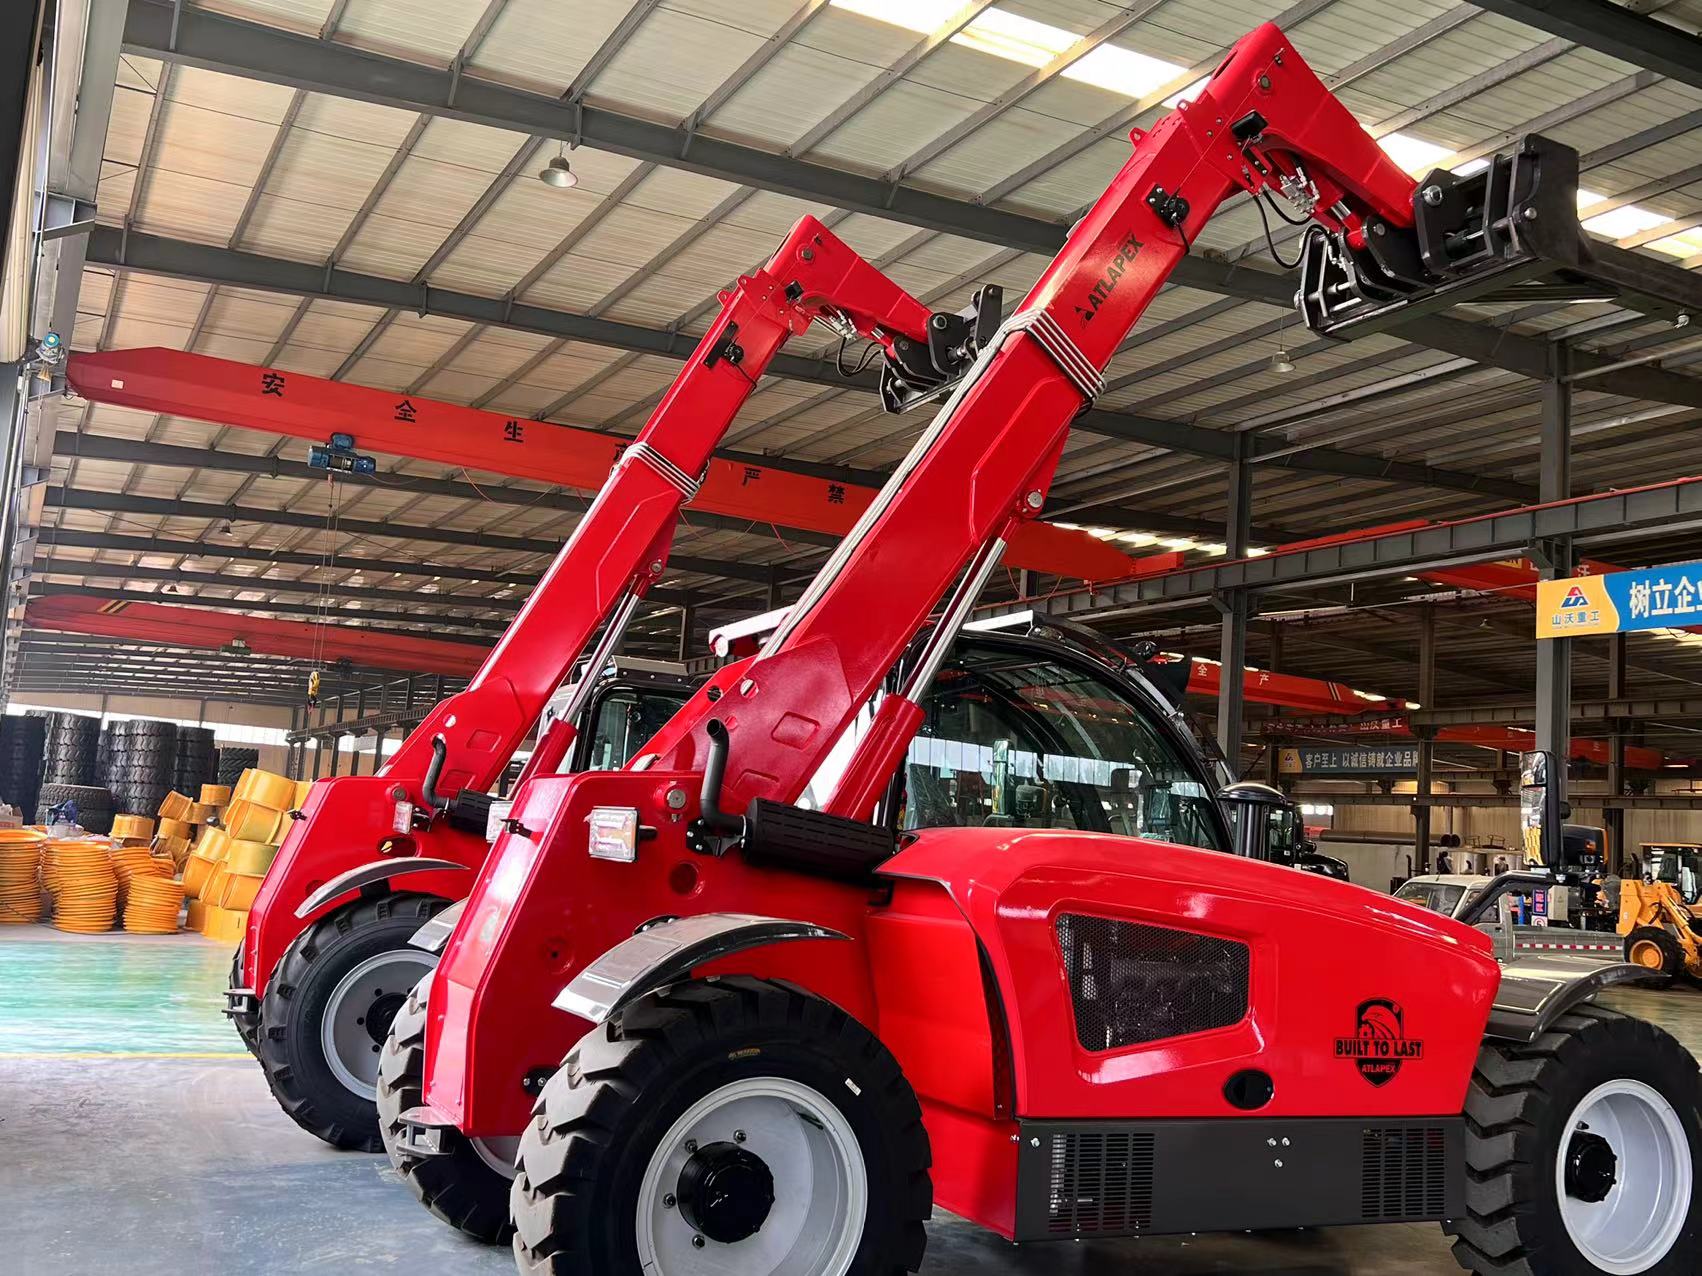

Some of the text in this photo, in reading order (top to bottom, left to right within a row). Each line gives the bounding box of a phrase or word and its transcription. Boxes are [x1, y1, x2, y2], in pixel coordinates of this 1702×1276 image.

[1087, 229, 1145, 311] ATLAPEX
[1551, 611, 1600, 625] 山沃重工
[1305, 752, 1337, 769] 客户至上
[1336, 1039, 1422, 1057] BUILT TO LAST
[1362, 1064, 1396, 1073] ATLAPEX
